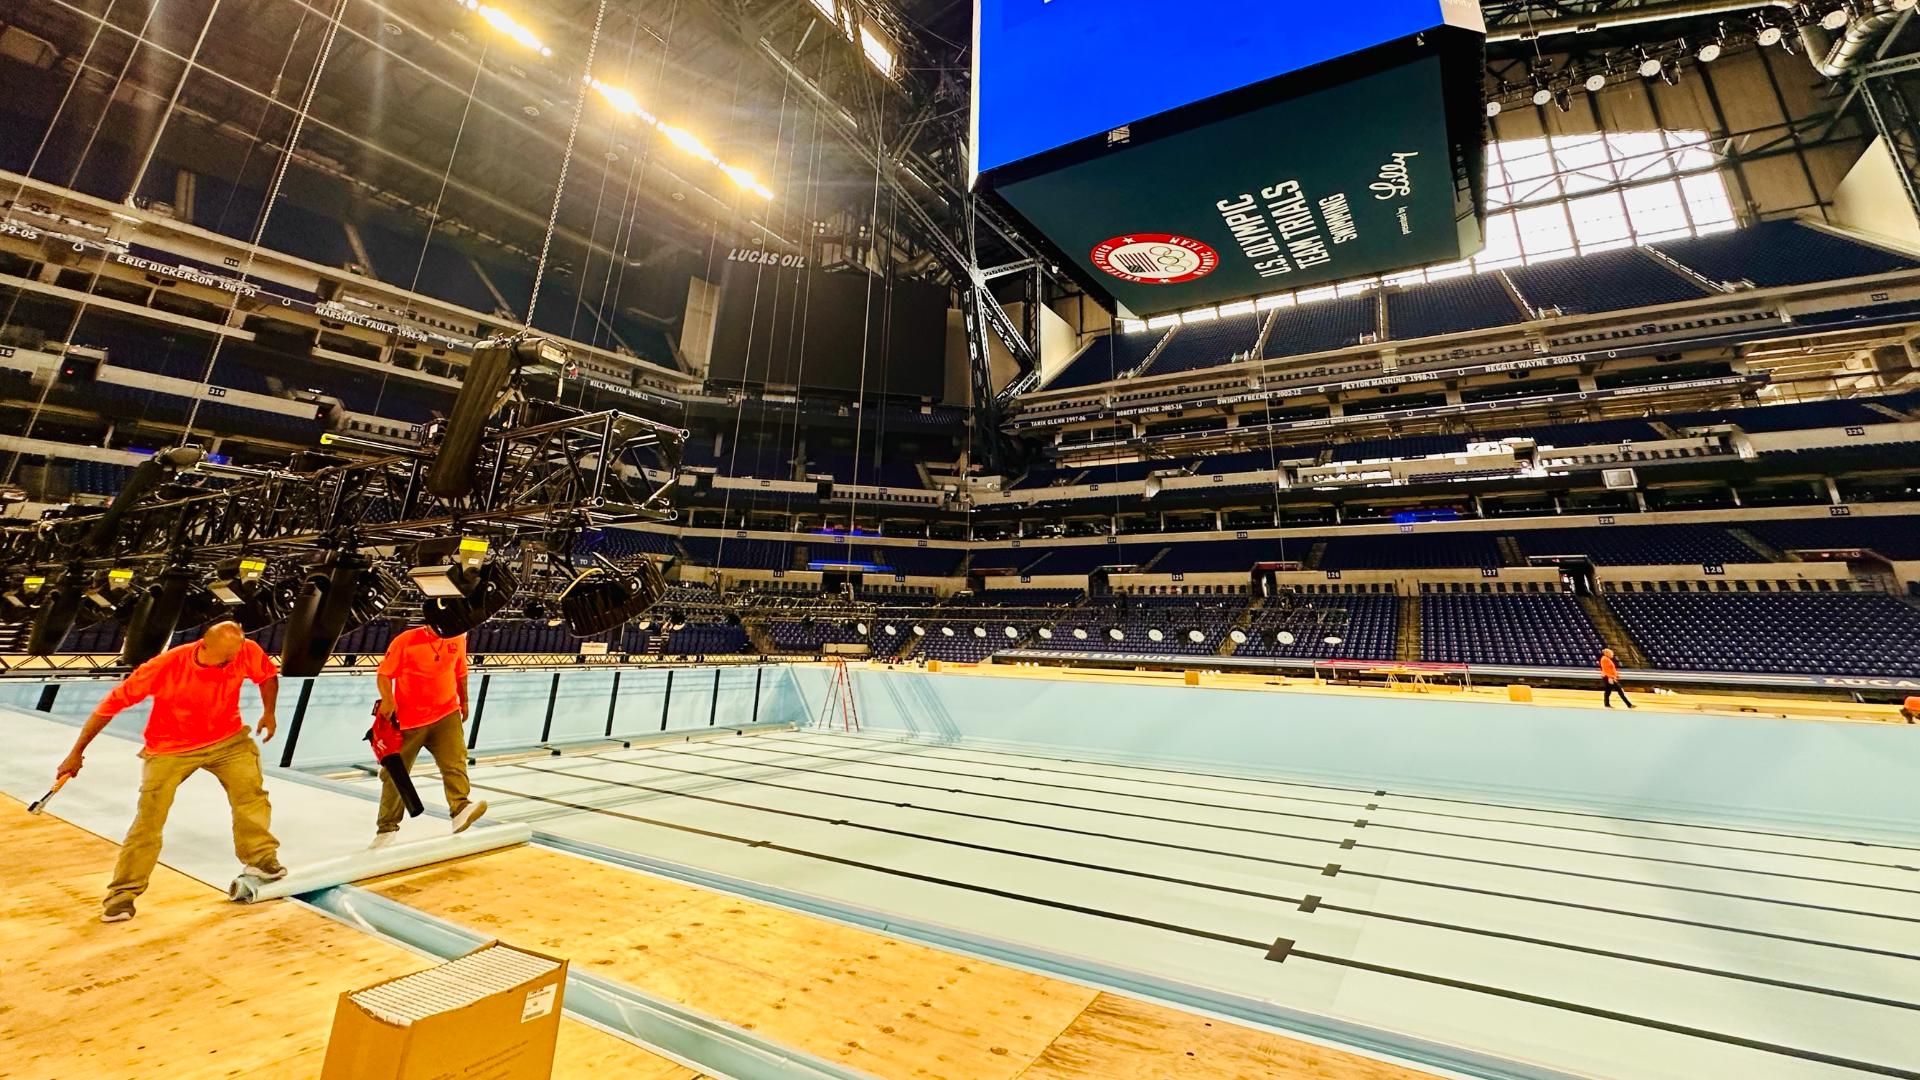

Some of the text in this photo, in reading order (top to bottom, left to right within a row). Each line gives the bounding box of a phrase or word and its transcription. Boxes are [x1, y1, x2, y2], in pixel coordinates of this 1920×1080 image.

[1368, 151, 1419, 200] Lilly
[1260, 179, 1331, 270] TEAM TRIALS
[1318, 192, 1358, 245] SWIMMING
[1169, 236, 1202, 251] TEAM
[1216, 193, 1292, 278] U.S. OLYMPIC
[728, 248, 805, 268] LUCAS OIL
[117, 255, 148, 270] ERIC
[149, 259, 213, 287] DICKERSON
[1102, 265, 1141, 282] UNITED
[315, 307, 364, 326] MARSHALL
[366, 319, 393, 334] FAULK
[1517, 359, 1548, 369] WAYNE
[1341, 380, 1371, 390] PEYTON
[1371, 375, 1406, 386] MANNING
[209, 387, 225, 396] 316
[1217, 396, 1241, 404] DWIGHT
[1091, 653, 1172, 661] STADIUM
[1823, 677, 1920, 687] LUCA
